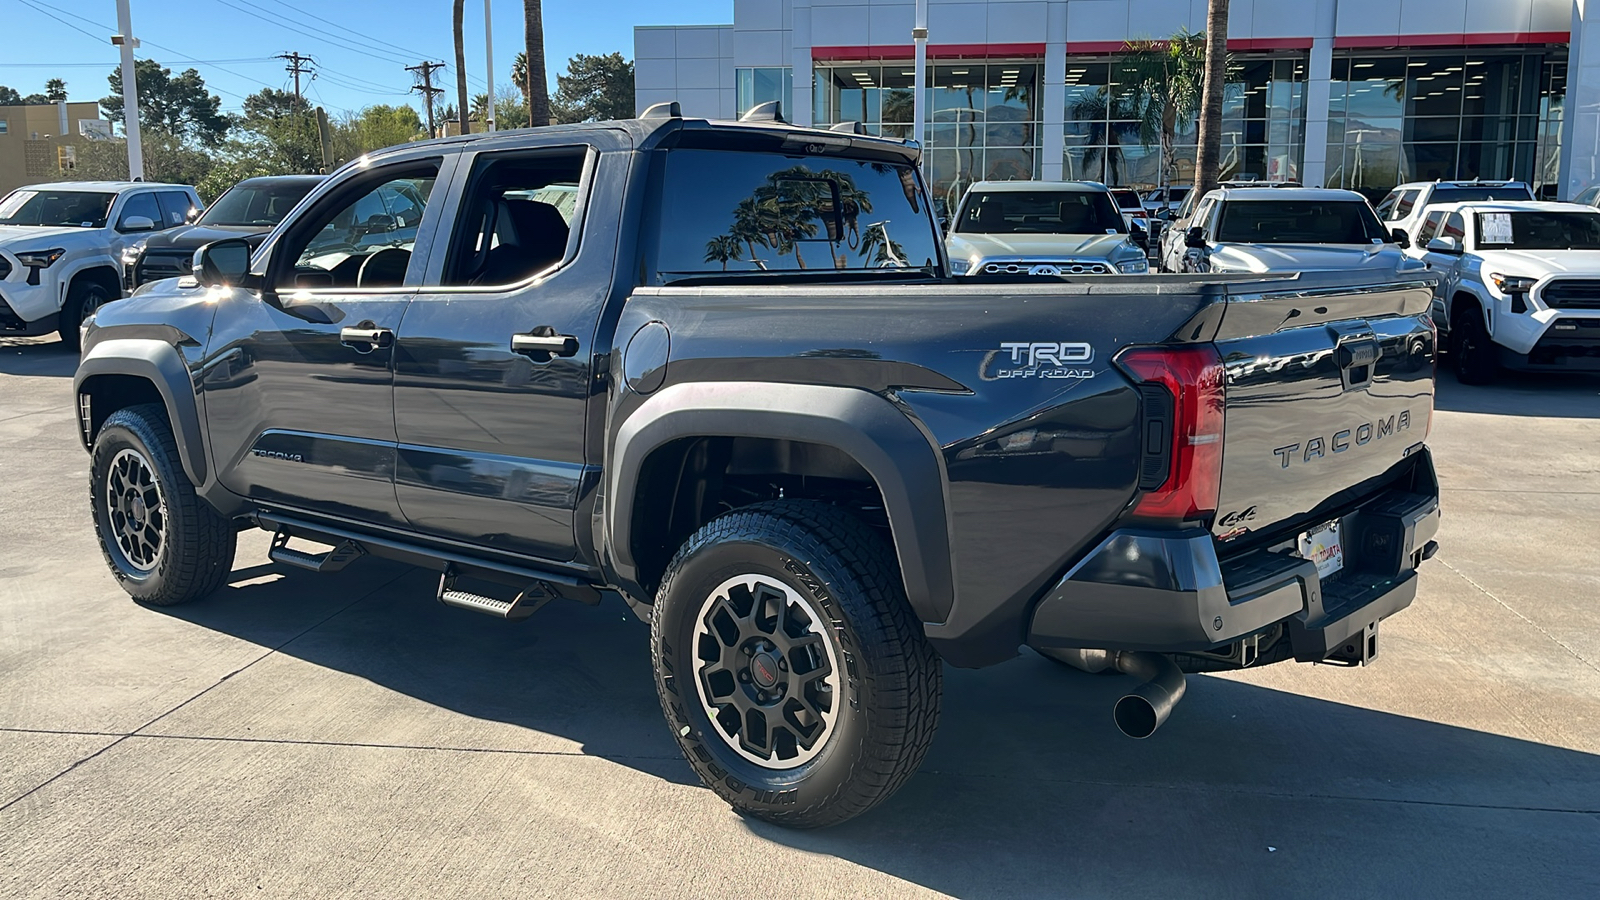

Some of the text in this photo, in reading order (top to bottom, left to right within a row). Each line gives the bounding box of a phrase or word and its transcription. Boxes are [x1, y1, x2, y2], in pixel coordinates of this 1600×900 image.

[1000, 342, 1093, 367] TRD
[997, 369, 1095, 378] OFF ROAD
[1273, 409, 1411, 469] TACOMA
[251, 448, 304, 463] TACOMA
[756, 659, 774, 682] TRD
